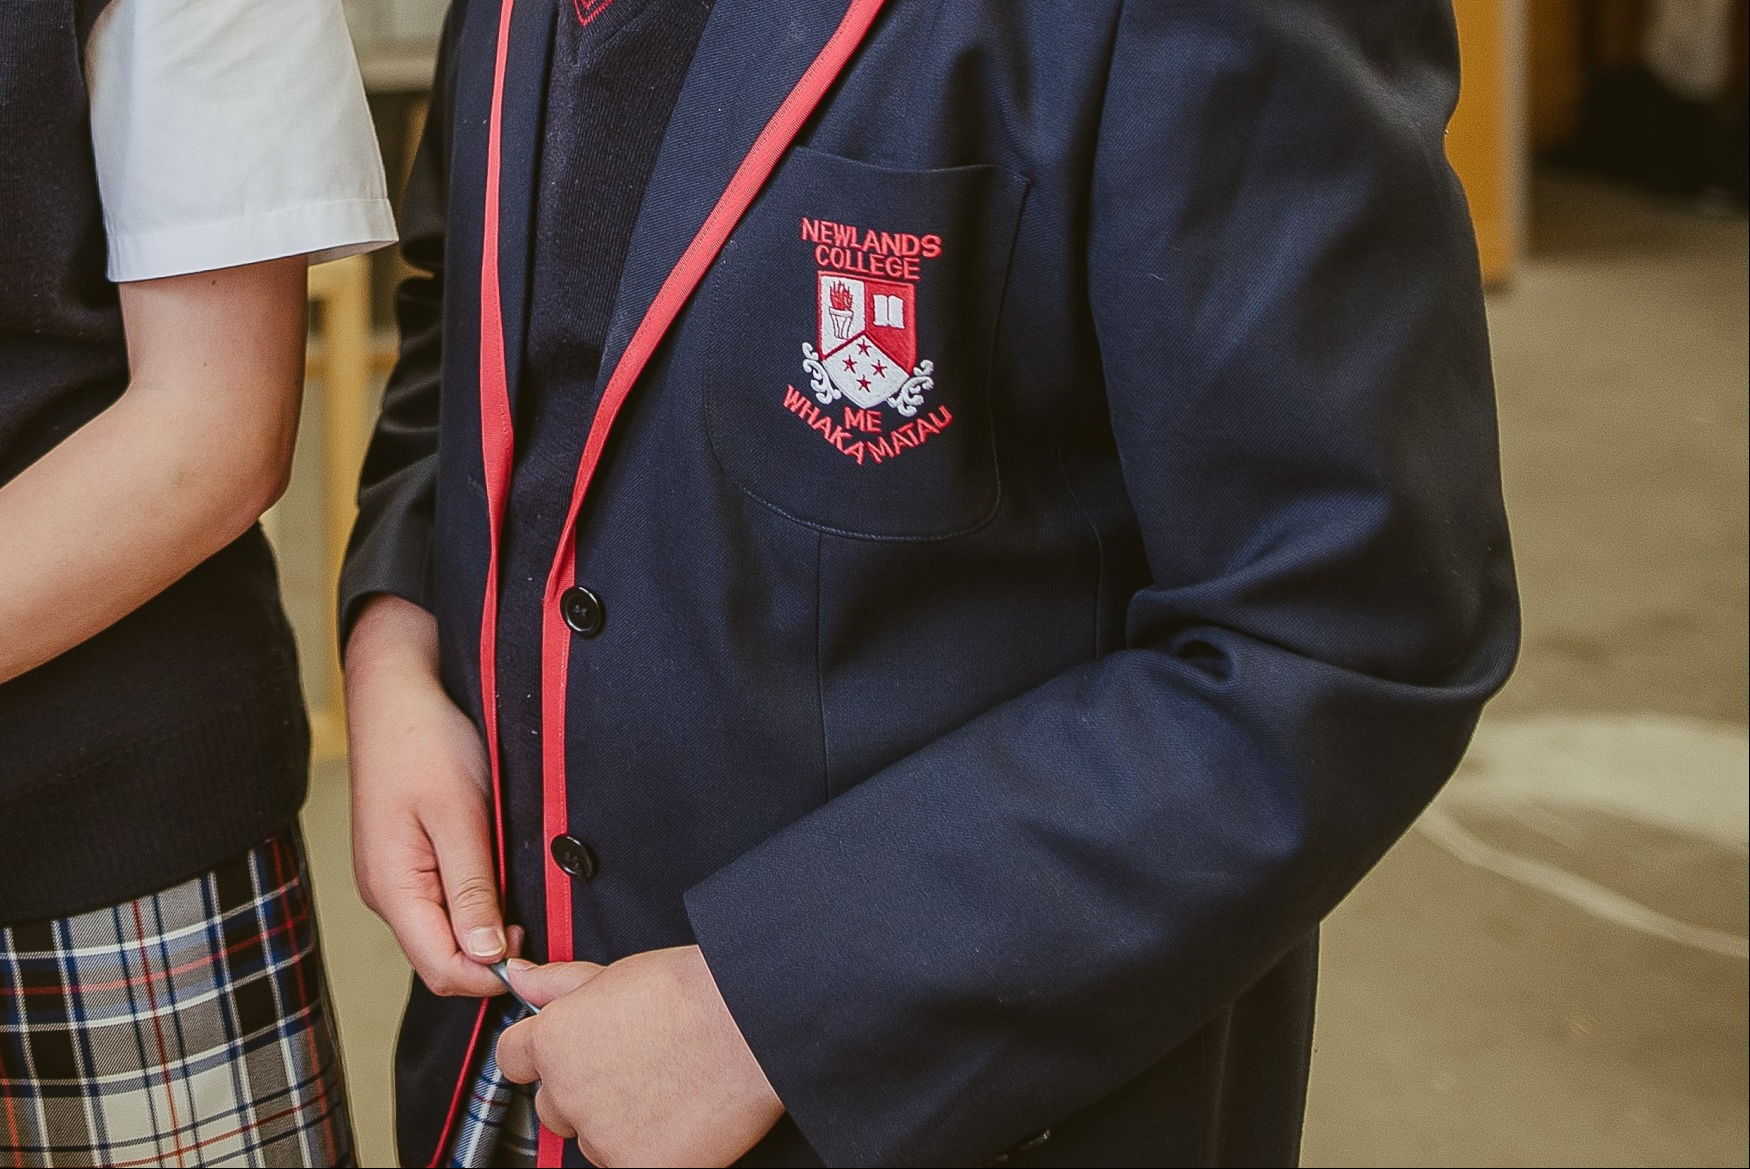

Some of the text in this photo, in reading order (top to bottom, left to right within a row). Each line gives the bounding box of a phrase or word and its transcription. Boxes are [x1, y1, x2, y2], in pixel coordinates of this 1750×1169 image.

[801, 217, 943, 259] NEWLANDS
[814, 245, 921, 281] COLLEGE
[782, 384, 953, 466] WHAKAMATAU
[843, 406, 883, 434] ME
